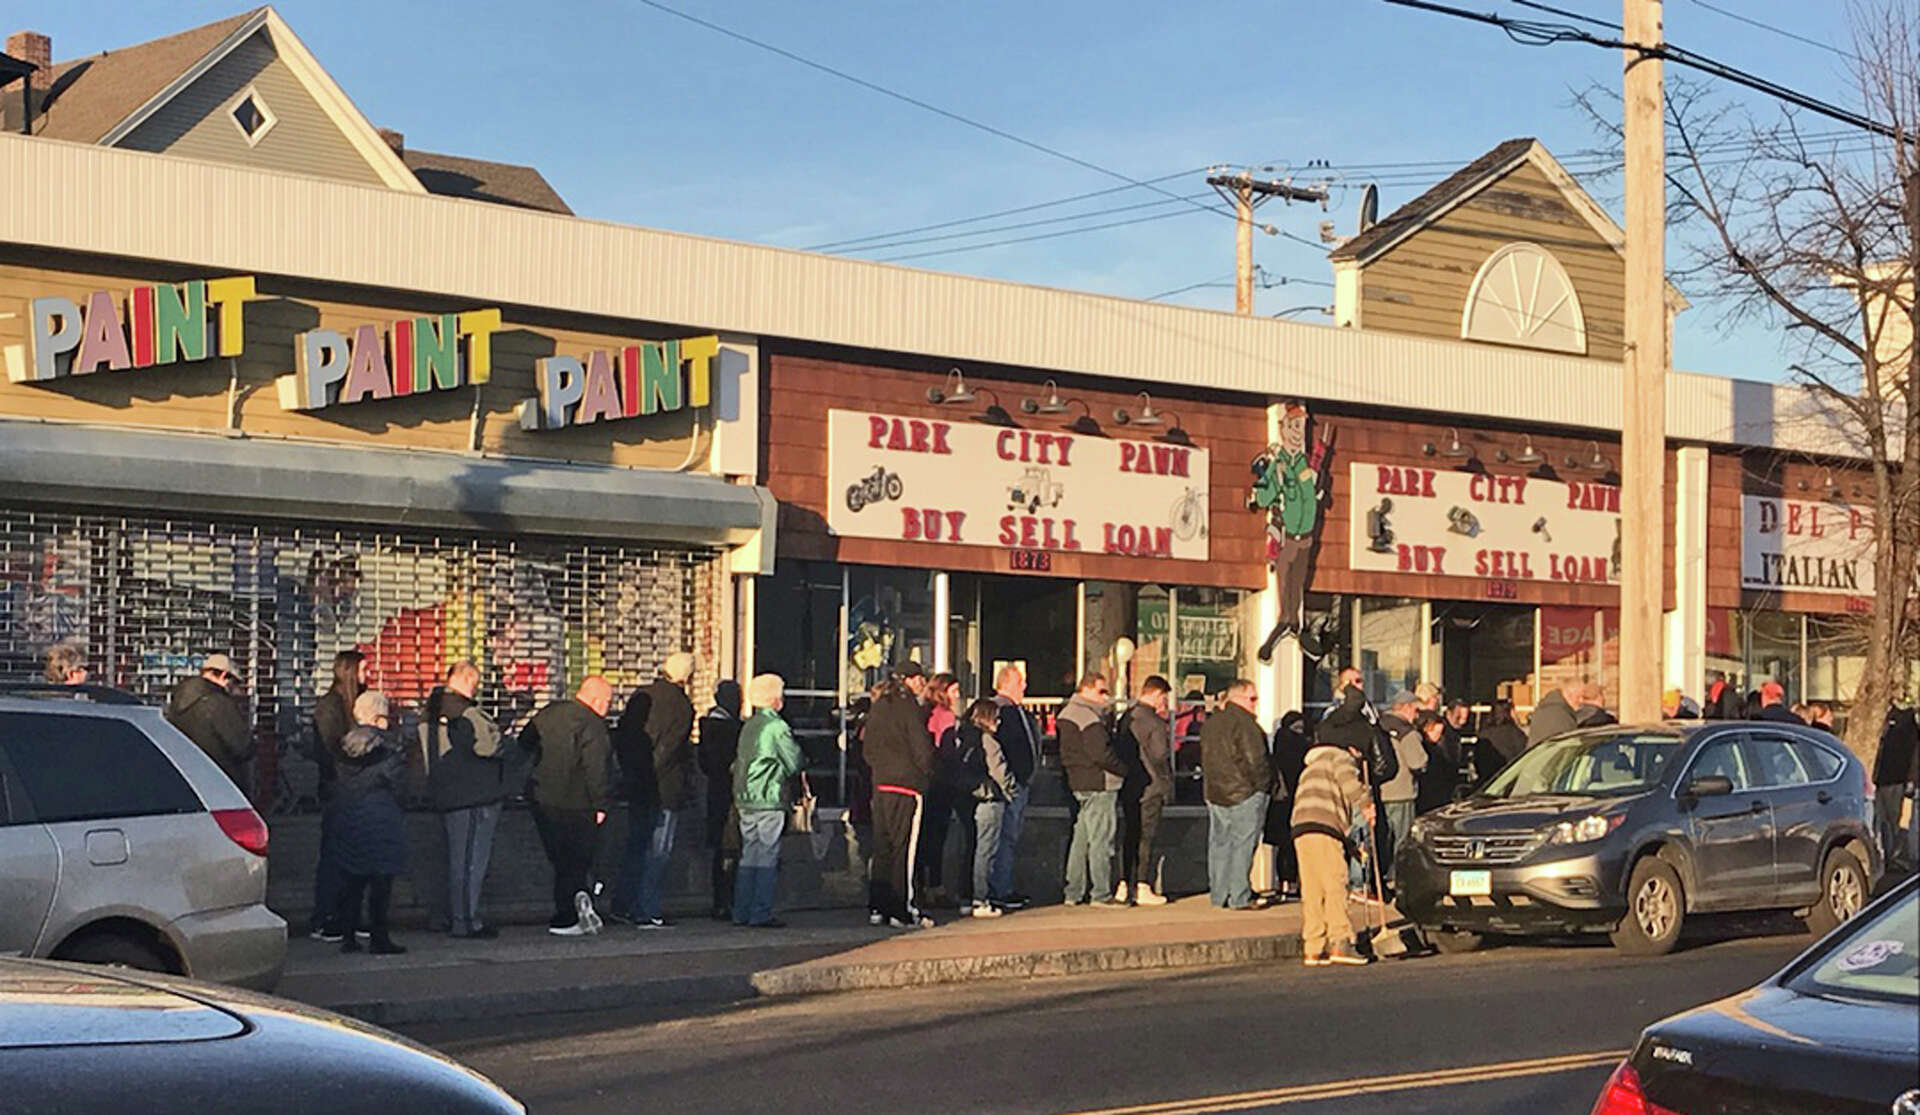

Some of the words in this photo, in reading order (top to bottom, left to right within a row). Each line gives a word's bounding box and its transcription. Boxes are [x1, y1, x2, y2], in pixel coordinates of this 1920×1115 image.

[31, 275, 256, 381] PAINT
[296, 308, 501, 409] PAINT
[537, 335, 719, 429] PAINT
[868, 415, 953, 455] PARK
[996, 429, 1074, 466] CITY
[1119, 442, 1190, 477] PAWN
[1376, 466, 1437, 498] PARK
[1469, 474, 1528, 504] CITY
[1567, 481, 1620, 513] PAWN
[901, 506, 967, 542] BUY
[998, 514, 1081, 551] SELL
[1103, 521, 1173, 558] LOAN
[1759, 501, 1824, 538] DEL
[1397, 543, 1447, 574] BUY
[1475, 549, 1533, 579] SELL
[1549, 553, 1608, 584] LOAN
[1761, 552, 1859, 590] ITALIAN
